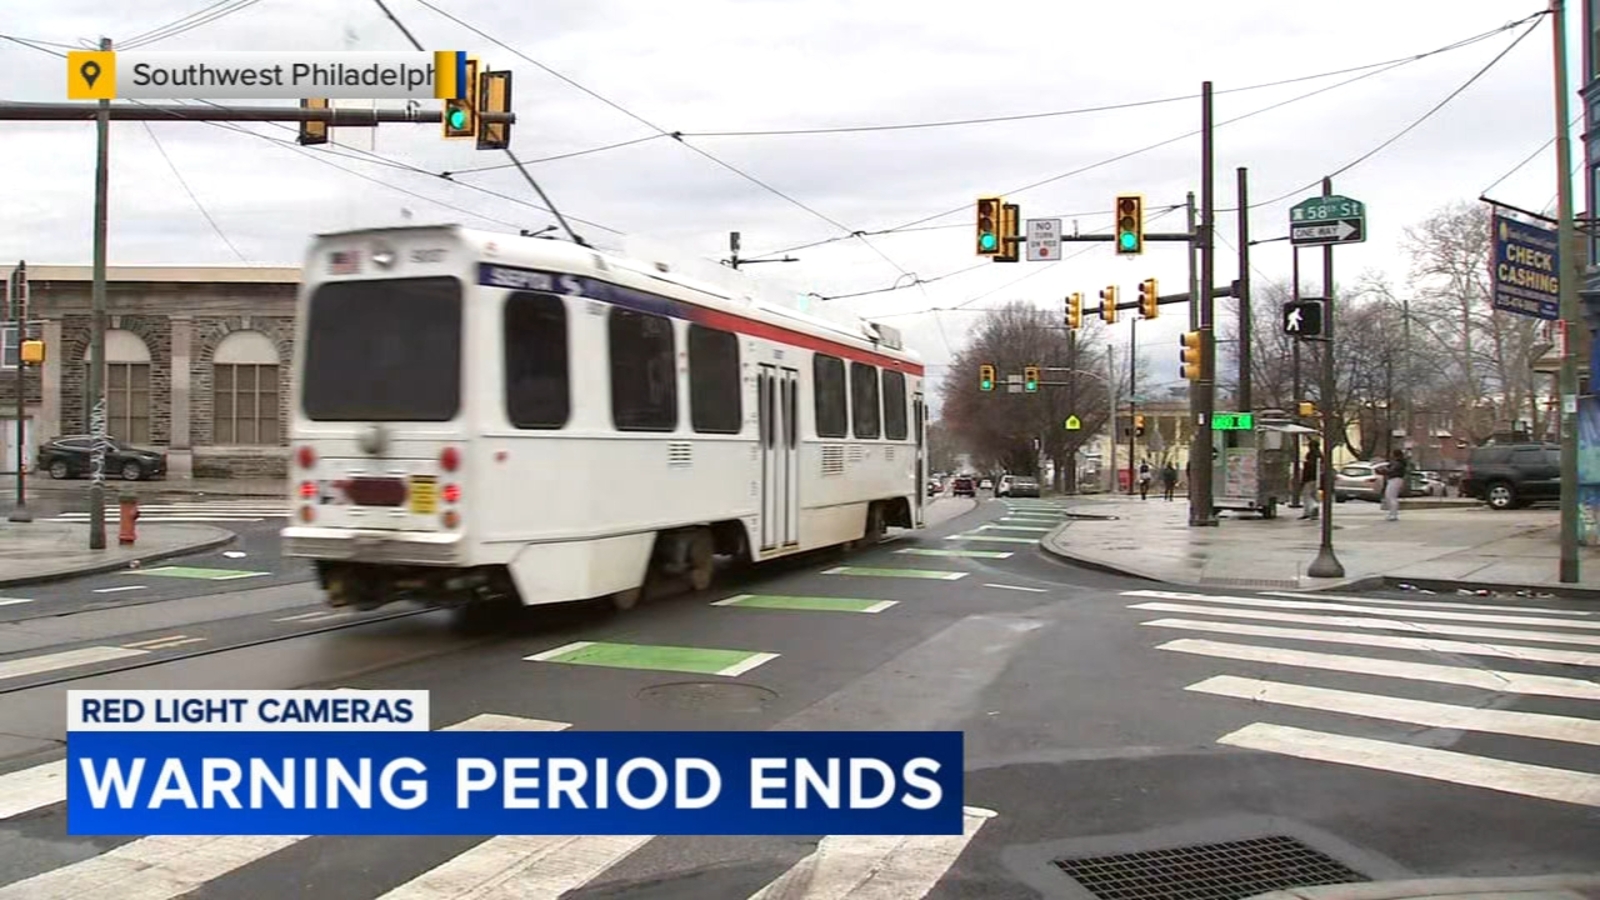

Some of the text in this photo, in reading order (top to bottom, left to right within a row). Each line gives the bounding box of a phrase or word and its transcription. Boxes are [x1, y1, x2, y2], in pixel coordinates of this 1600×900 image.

[1340, 202, 1360, 217] St
[1035, 221, 1052, 231] NO
[1294, 226, 1338, 238] ONE WAY
[1506, 243, 1552, 272] CHECK
[490, 267, 554, 291] SEPTA
[1498, 263, 1559, 294] CASHING
